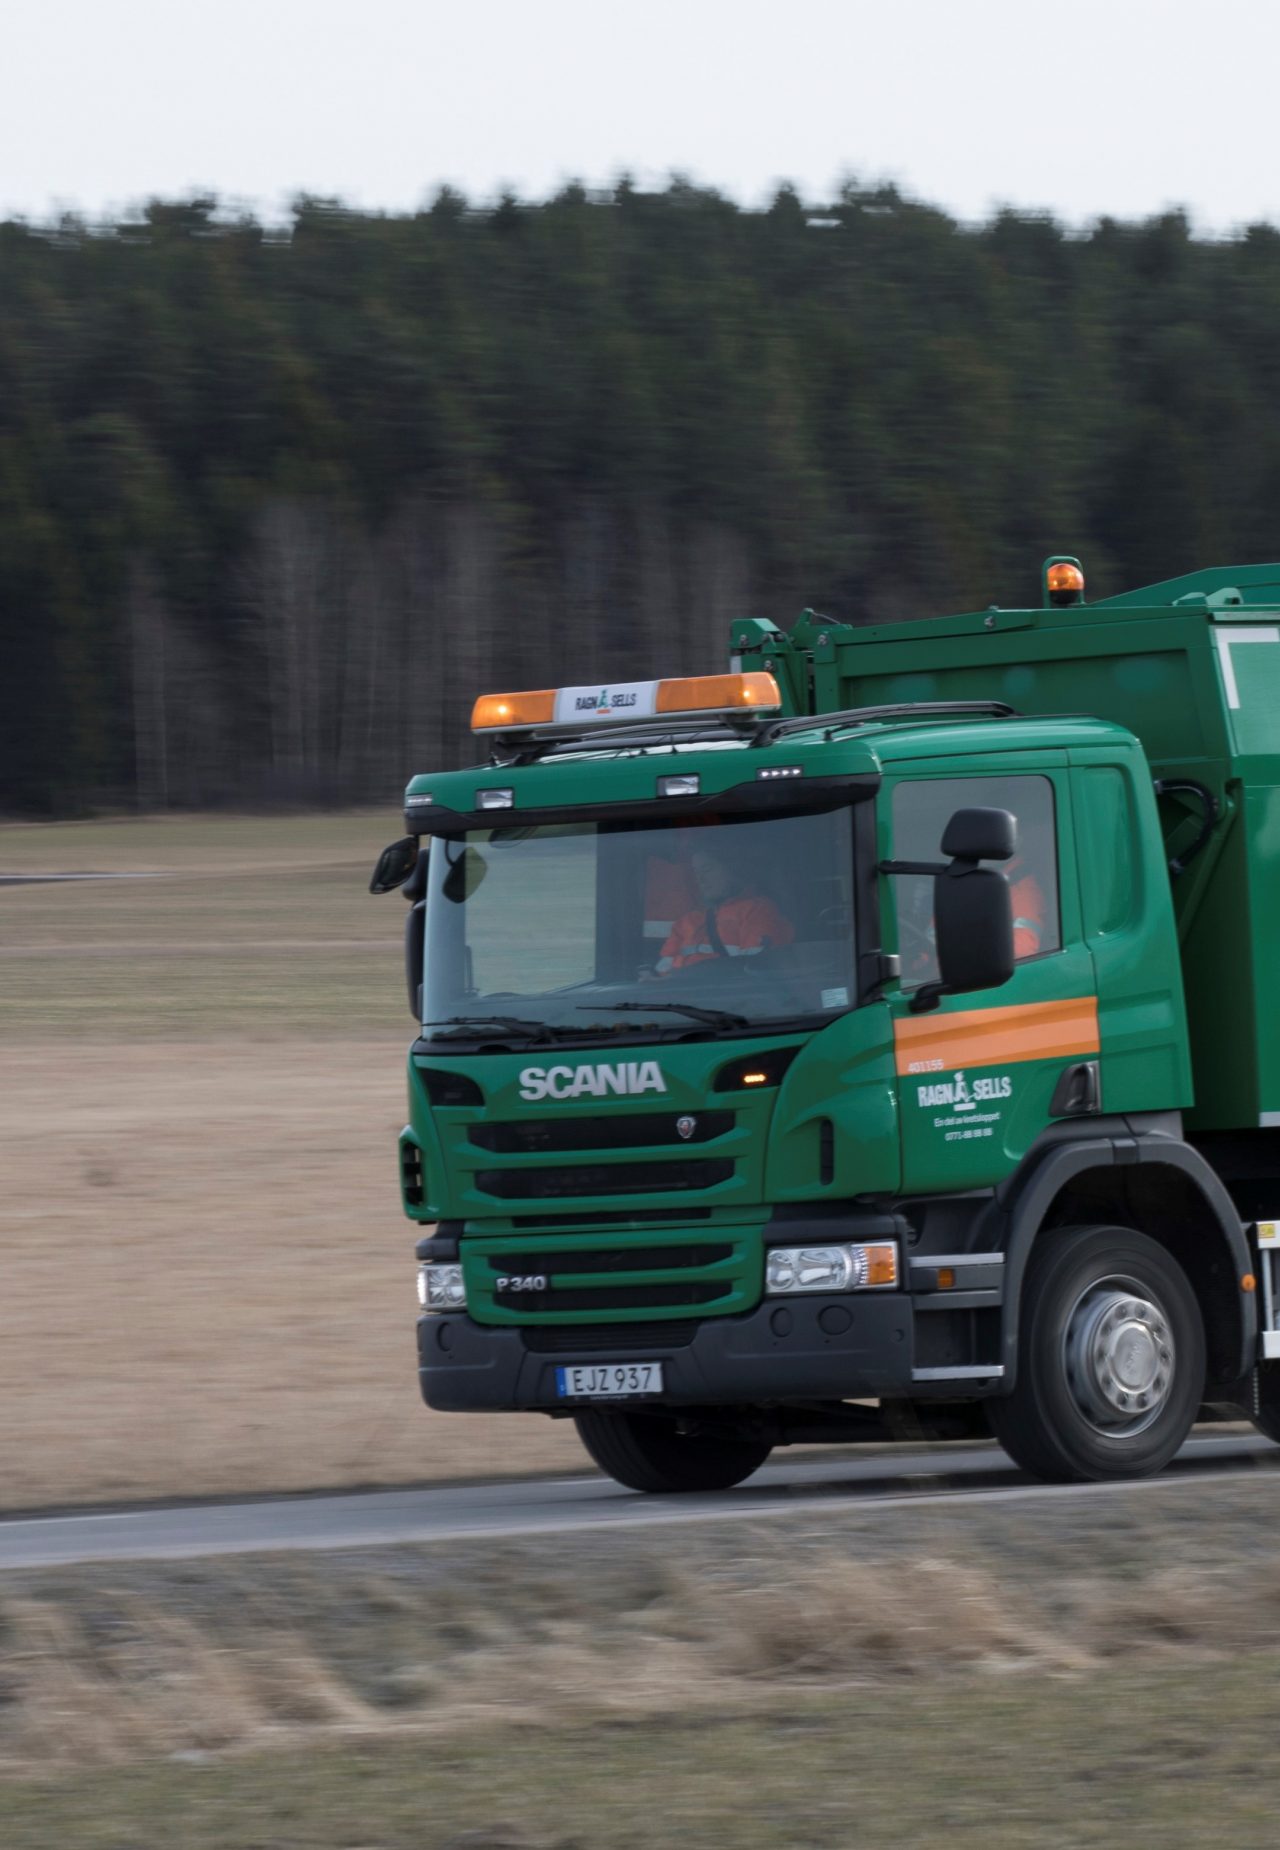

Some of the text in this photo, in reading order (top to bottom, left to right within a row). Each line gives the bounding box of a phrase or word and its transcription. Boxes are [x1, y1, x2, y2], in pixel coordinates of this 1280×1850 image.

[519, 1061, 667, 1101] SCANIA
[973, 1076, 1012, 1100] SELLS
[496, 1276, 546, 1292] P 340
[573, 1367, 652, 1392] EJZ 937
